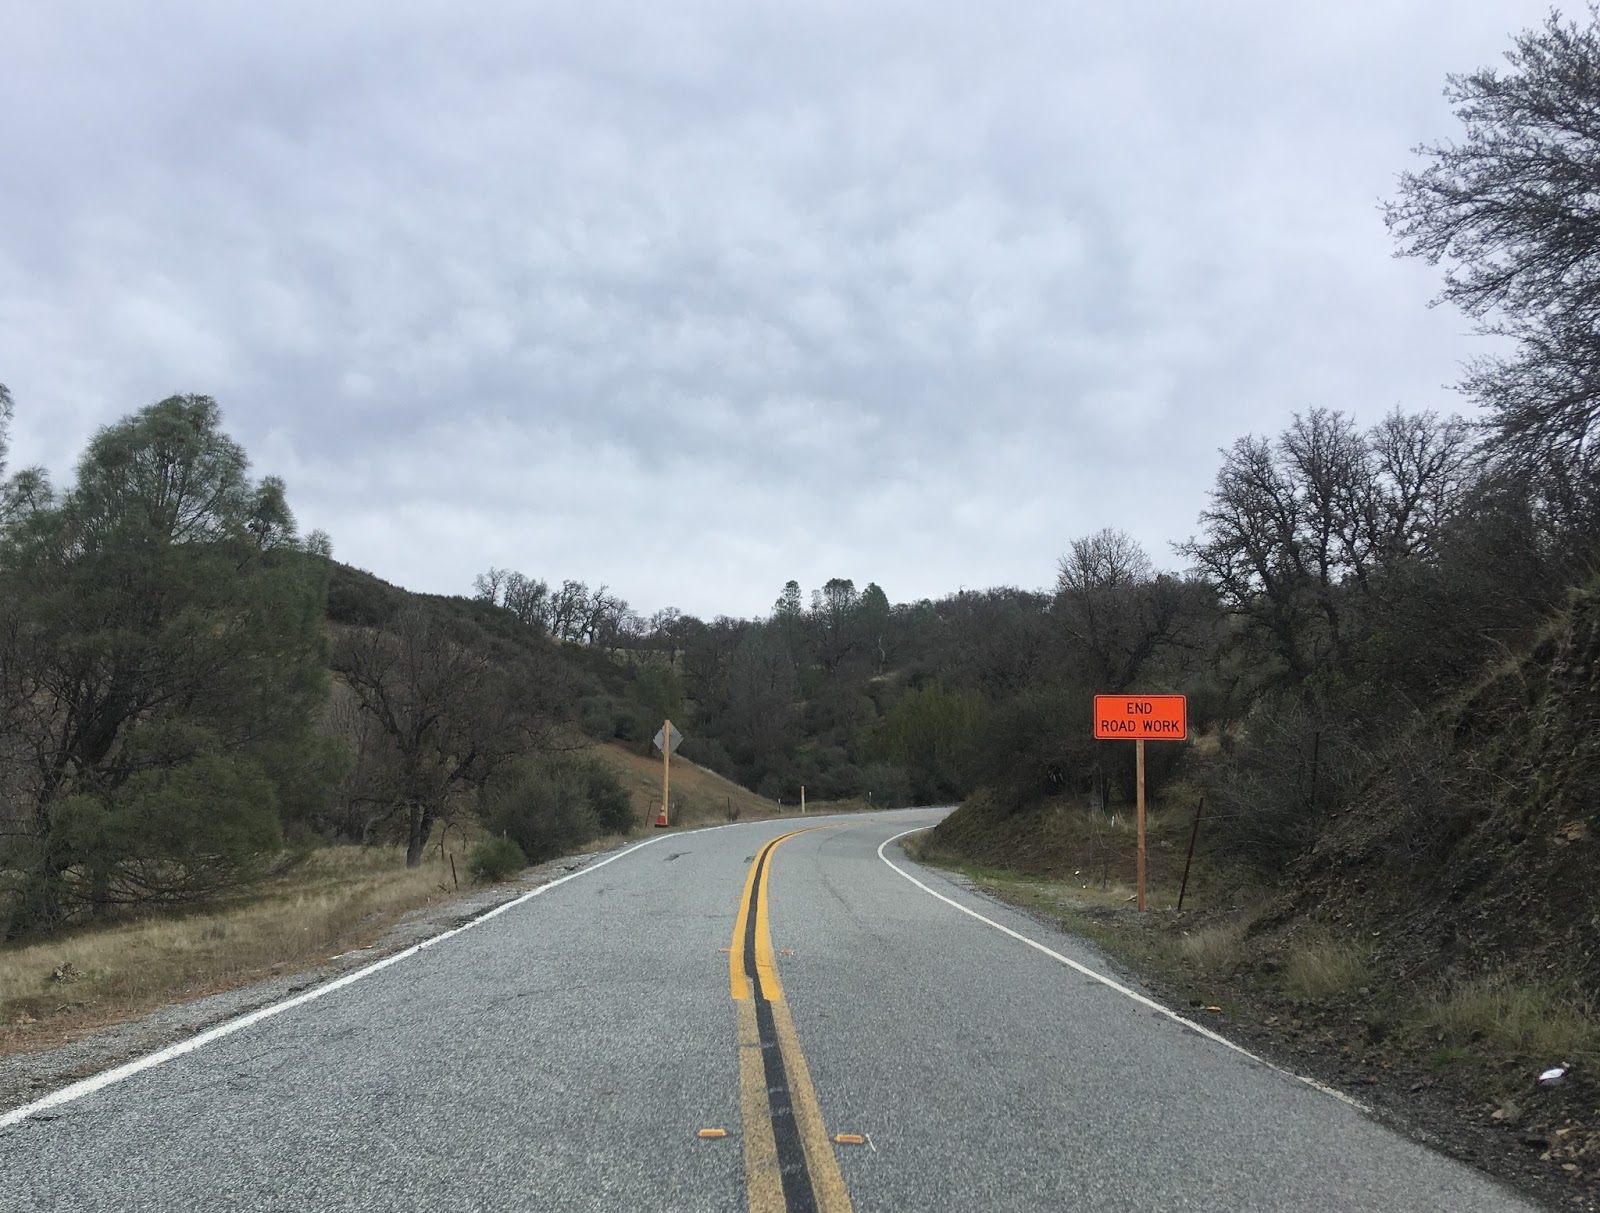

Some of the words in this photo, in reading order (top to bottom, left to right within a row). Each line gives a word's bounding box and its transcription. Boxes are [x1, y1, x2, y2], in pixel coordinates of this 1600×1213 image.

[1126, 702, 1153, 715] END
[1101, 719, 1136, 732] ROAD
[1142, 719, 1180, 732] WORK
